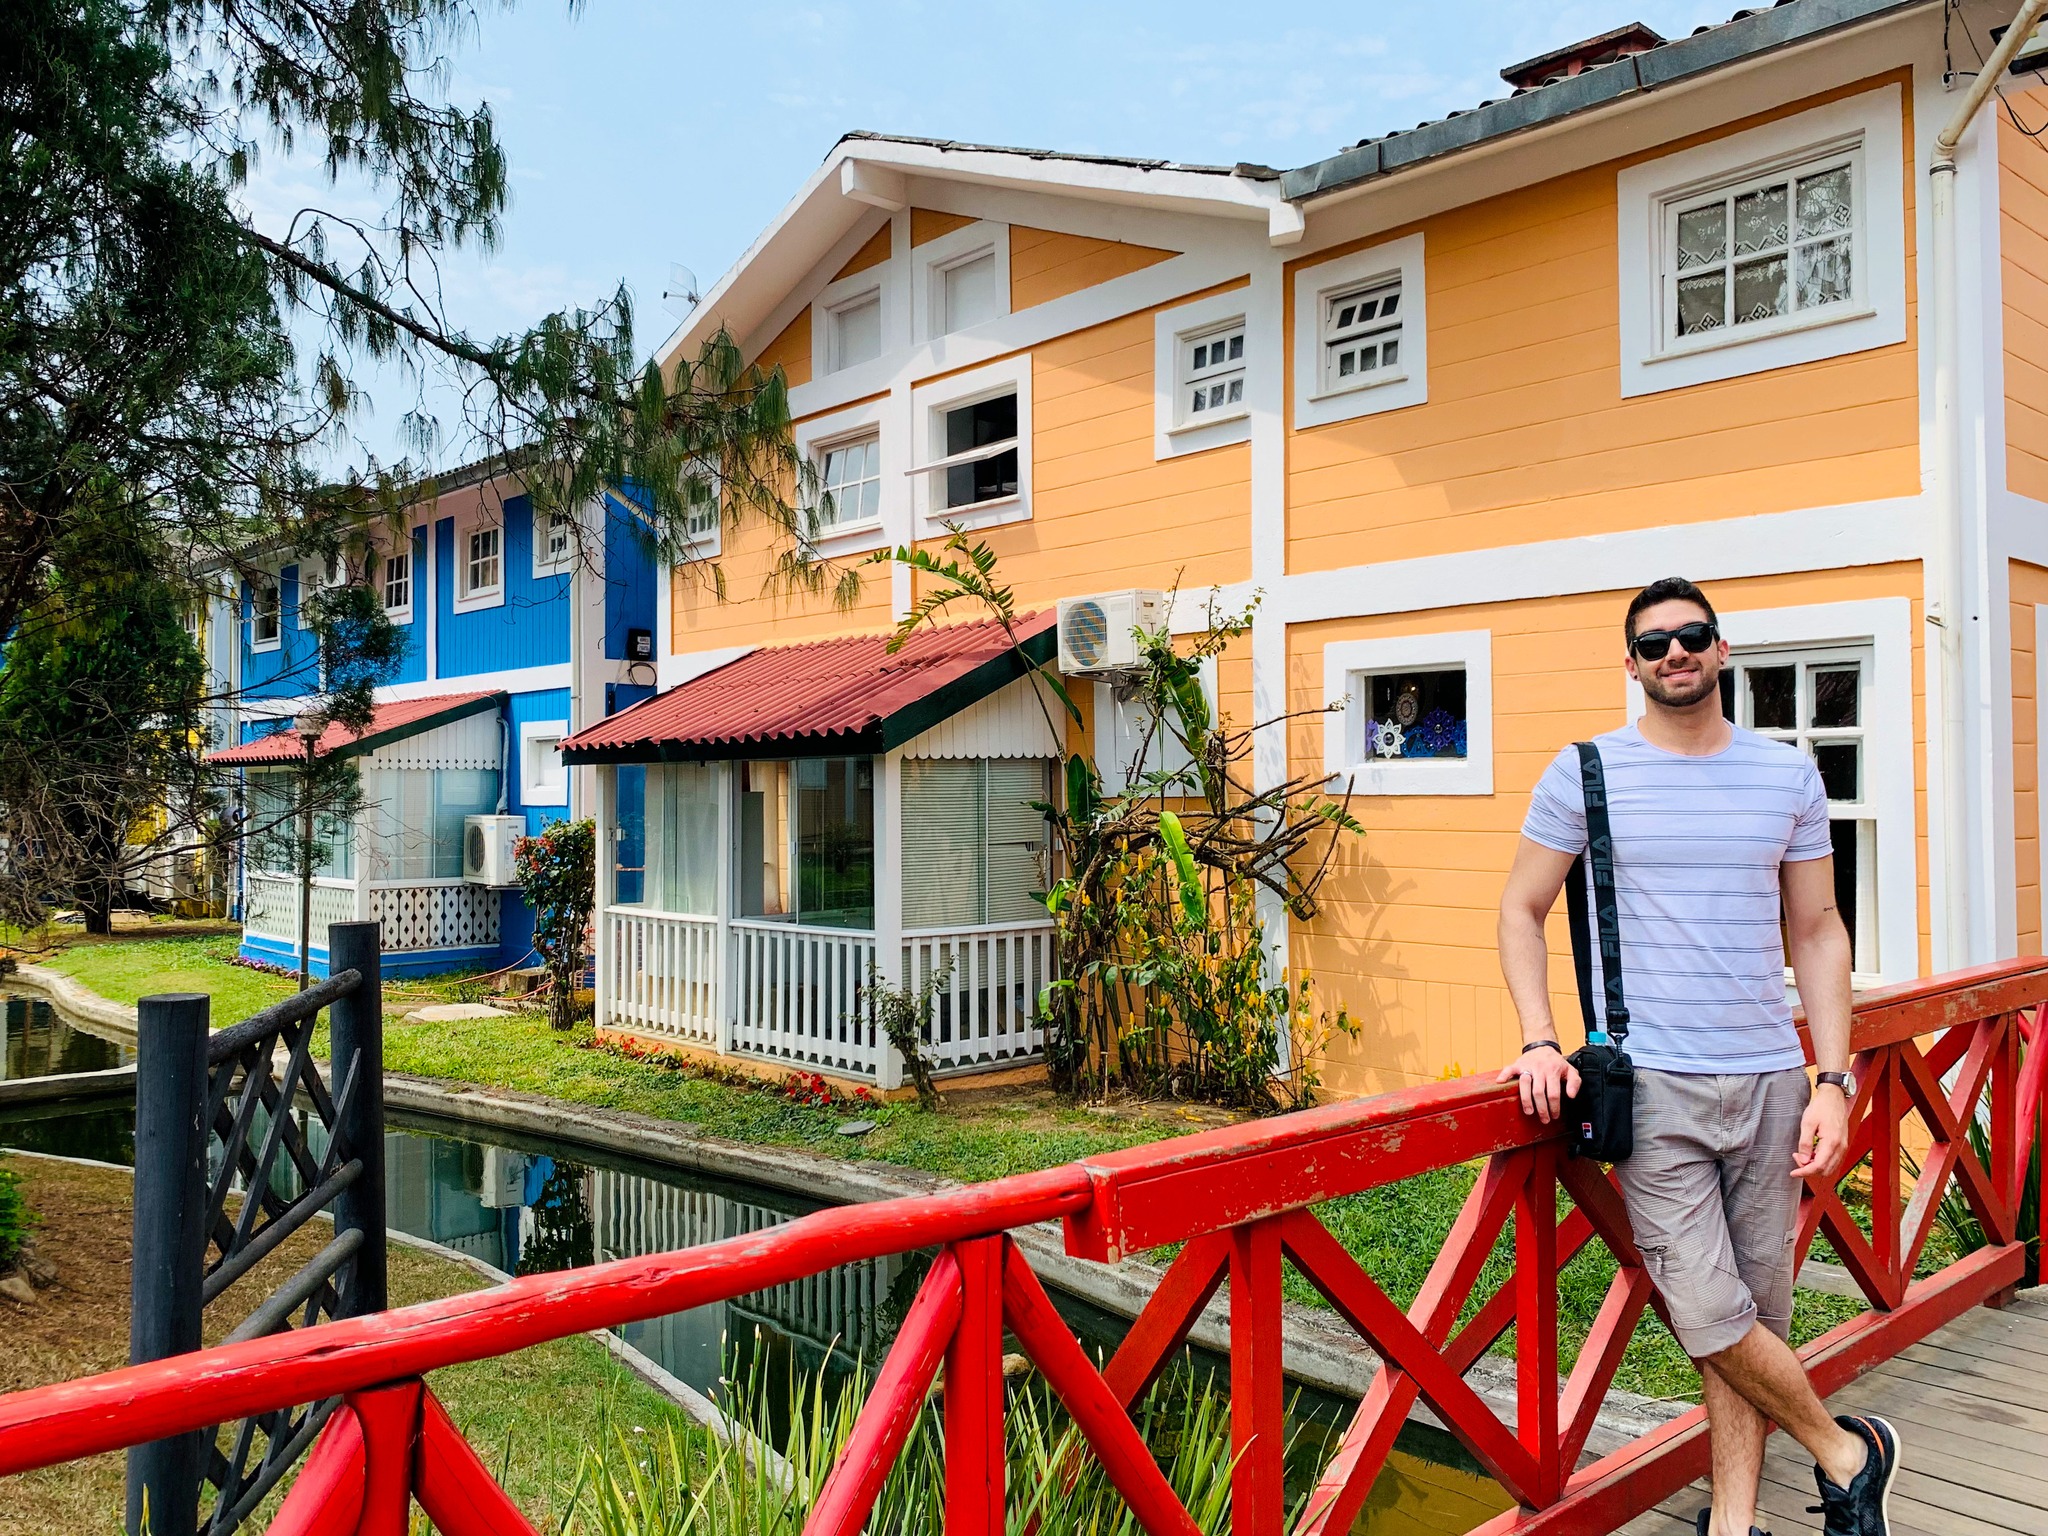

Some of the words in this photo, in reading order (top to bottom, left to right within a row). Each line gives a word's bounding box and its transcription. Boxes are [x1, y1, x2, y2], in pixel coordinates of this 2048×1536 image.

[1583, 758, 1605, 808] FILA
[1592, 835, 1613, 887] FILA
[1599, 904, 1620, 958] FILA
